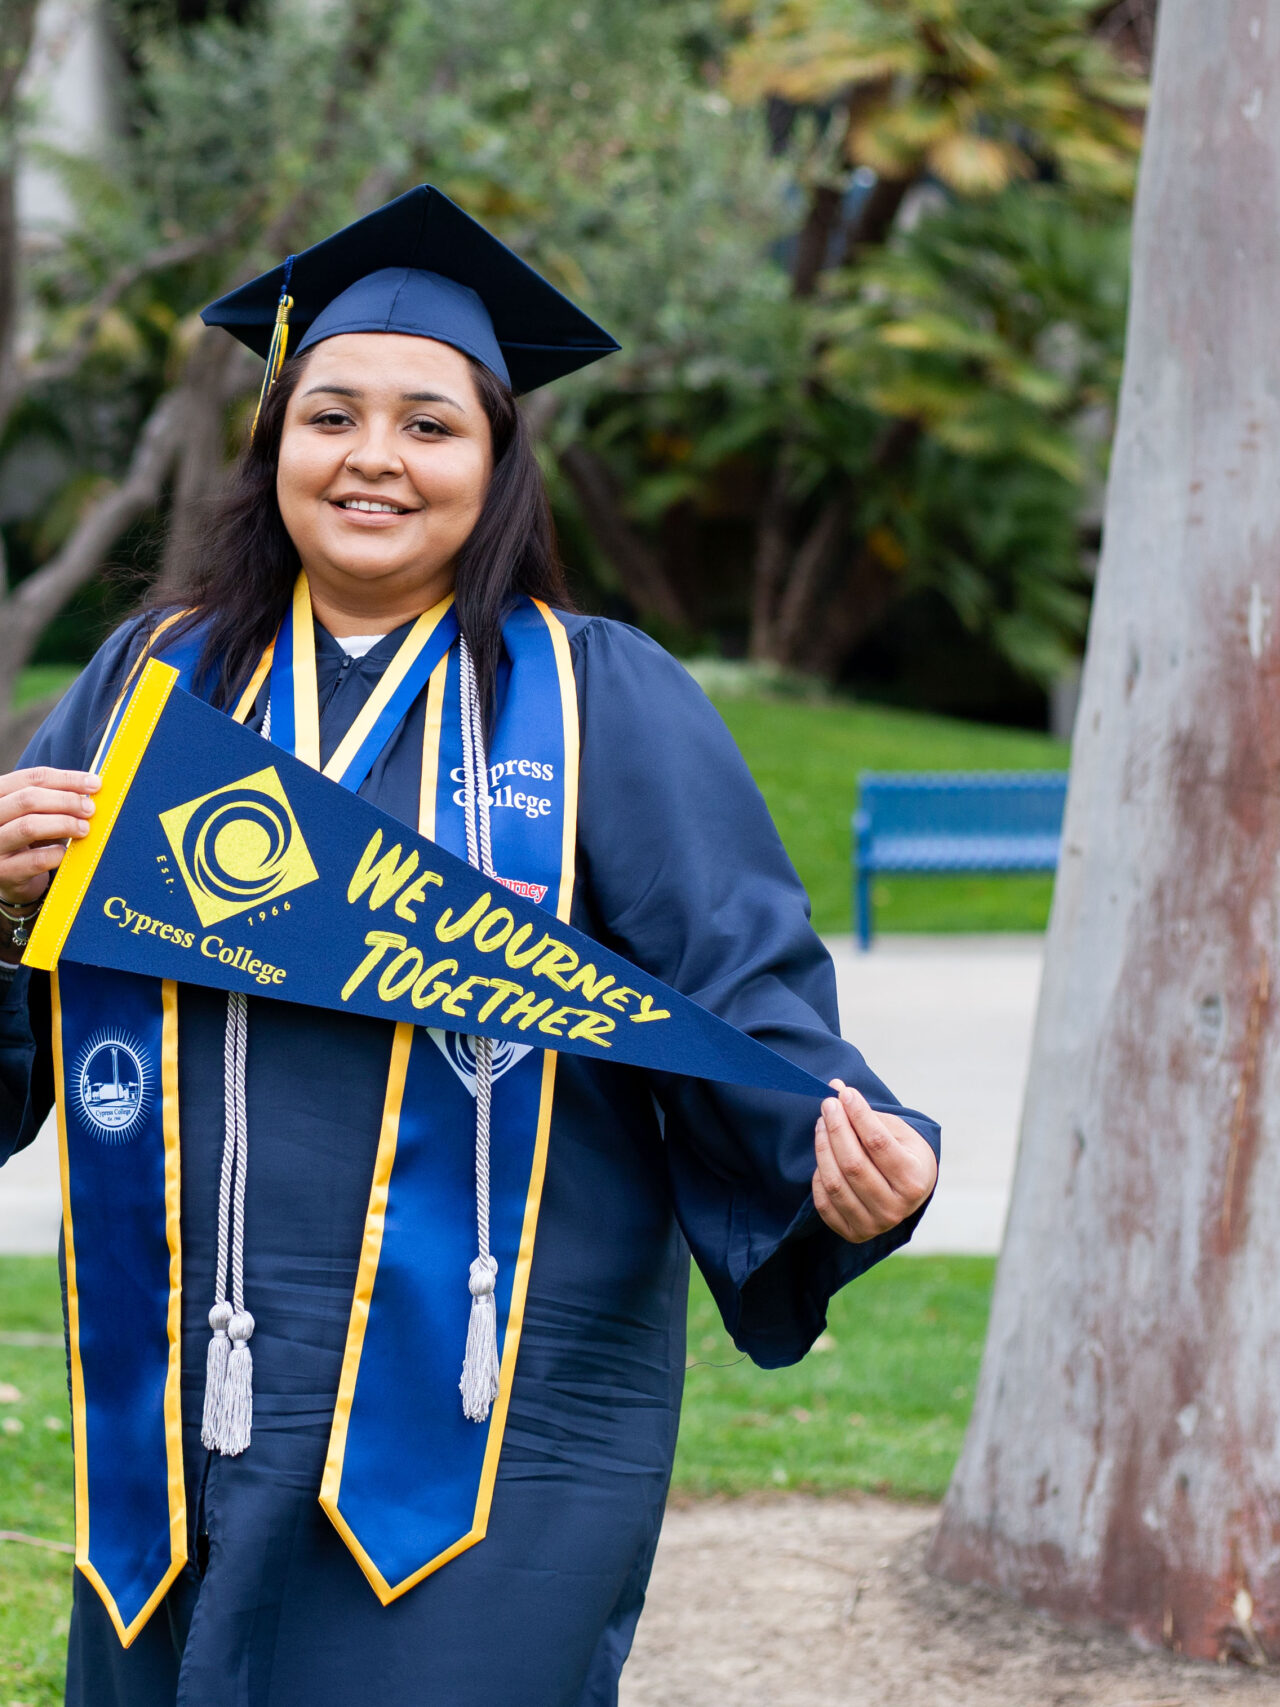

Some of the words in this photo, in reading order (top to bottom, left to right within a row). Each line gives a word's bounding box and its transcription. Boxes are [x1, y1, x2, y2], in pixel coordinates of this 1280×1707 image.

[450, 759, 554, 788] Cpress
[103, 896, 195, 948] Cypress
[200, 935, 287, 984] College
[247, 901, 291, 926] 1966
[347, 828, 443, 923] WE
[435, 892, 670, 1023] JOURNEY
[341, 931, 616, 1047] TOGETHER
